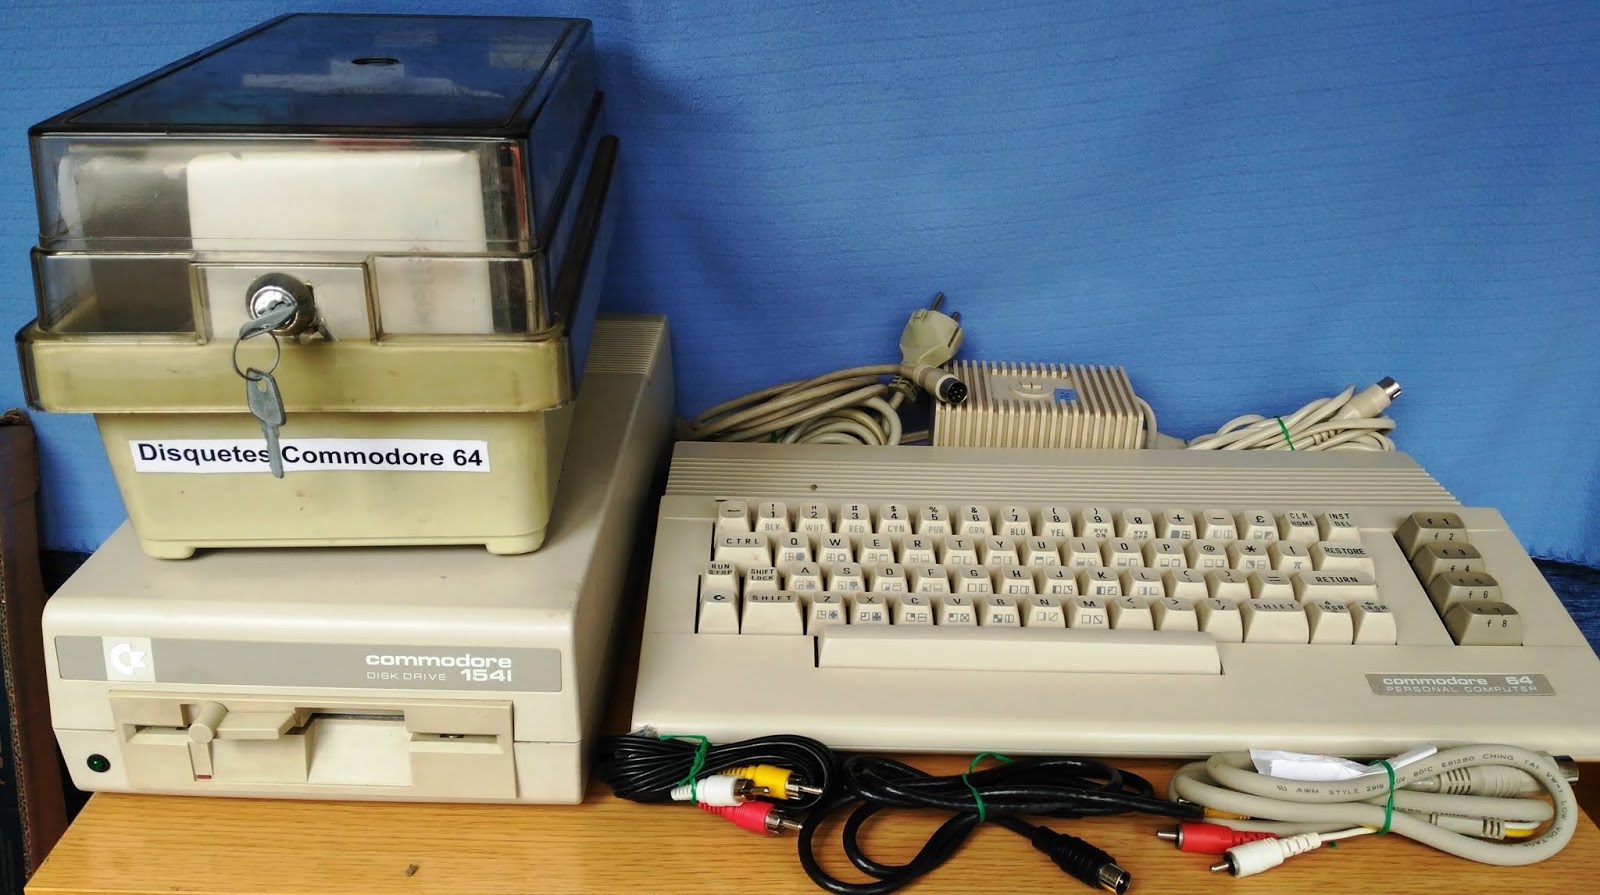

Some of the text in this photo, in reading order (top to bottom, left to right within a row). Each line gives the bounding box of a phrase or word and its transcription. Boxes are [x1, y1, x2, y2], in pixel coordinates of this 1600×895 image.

[137, 443, 483, 467] Disquetes Commodore 64
[851, 512, 859, 520] 3
[890, 512, 898, 520] 4
[931, 513, 938, 521] 5
[972, 514, 980, 522] 6
[1011, 514, 1019, 522] 7
[1052, 515, 1061, 523] 8
[1094, 515, 1102, 523] 9
[1255, 515, 1265, 523] £
[765, 523, 781, 531] BLK
[805, 524, 824, 532] WHT
[848, 525, 865, 534] RED
[887, 524, 905, 533] CYN
[928, 526, 944, 534] PUR
[968, 526, 986, 534] GRN
[1010, 528, 1026, 536] BLU
[1050, 528, 1066, 537] YEL
[790, 537, 798, 546] Q
[829, 538, 841, 546] W
[873, 539, 880, 547] E
[914, 540, 922, 548] R
[956, 540, 963, 548] T
[996, 541, 1004, 549] Y
[1037, 541, 1046, 549] U
[1120, 542, 1129, 550] O
[1203, 544, 1216, 553] @
[1323, 546, 1366, 555] RESTORE
[843, 567, 851, 575] S
[885, 568, 894, 576] D
[1012, 570, 1021, 578] H
[1097, 571, 1107, 579] K
[1140, 572, 1149, 580] L
[1039, 598, 1050, 606] N
[365, 653, 512, 668] commodore
[366, 671, 399, 680] DISK
[402, 672, 447, 681] DRIVE
[1382, 676, 1534, 686] commodore 64
[1386, 685, 1538, 693] PERSONAL COMPUTER
[1328, 788, 1360, 796] STYLE
[1482, 753, 1515, 761] CHING
